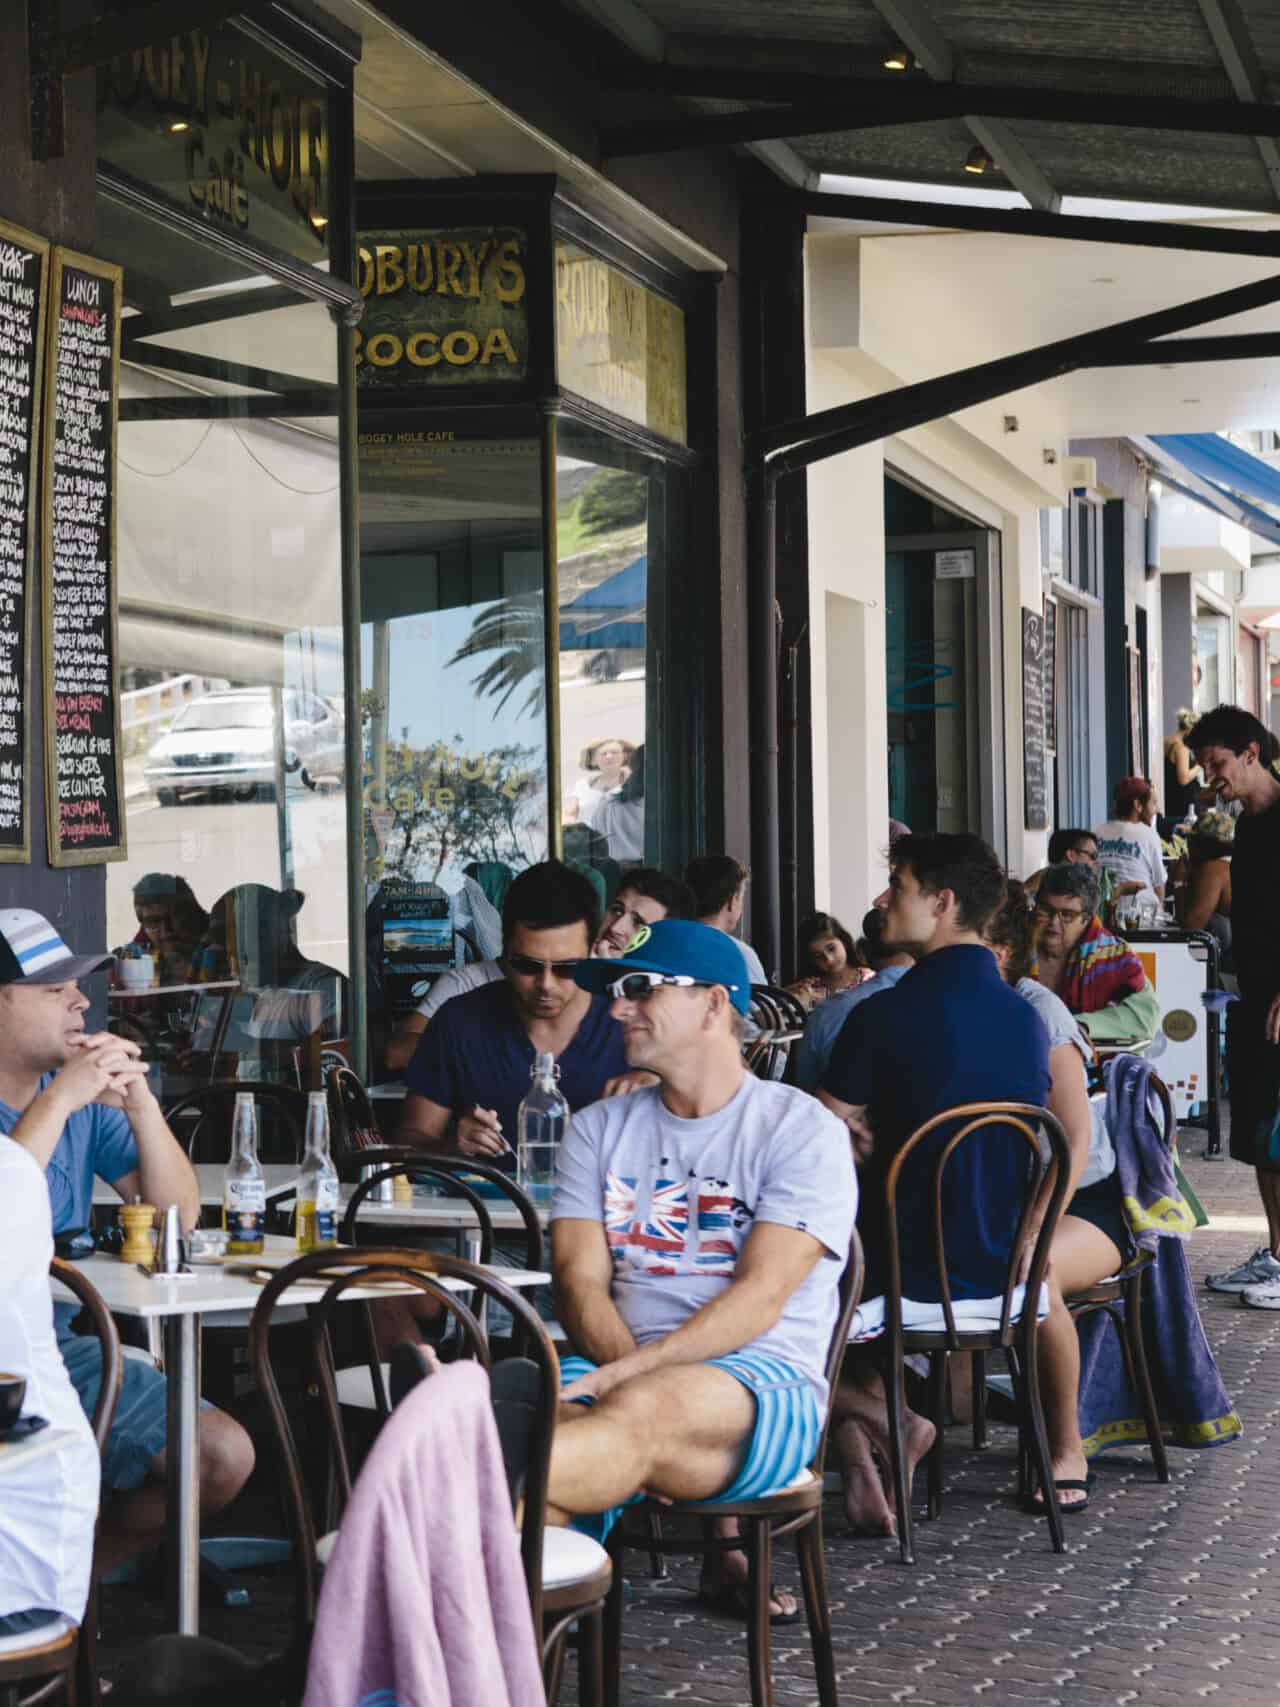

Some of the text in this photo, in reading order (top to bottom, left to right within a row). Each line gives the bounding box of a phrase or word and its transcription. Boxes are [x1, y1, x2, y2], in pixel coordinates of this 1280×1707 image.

[67, 274, 100, 306] LUNCH
[397, 432, 424, 443] HOLE
[427, 431, 455, 442] CAFE
[71, 775, 107, 798] COUNTER
